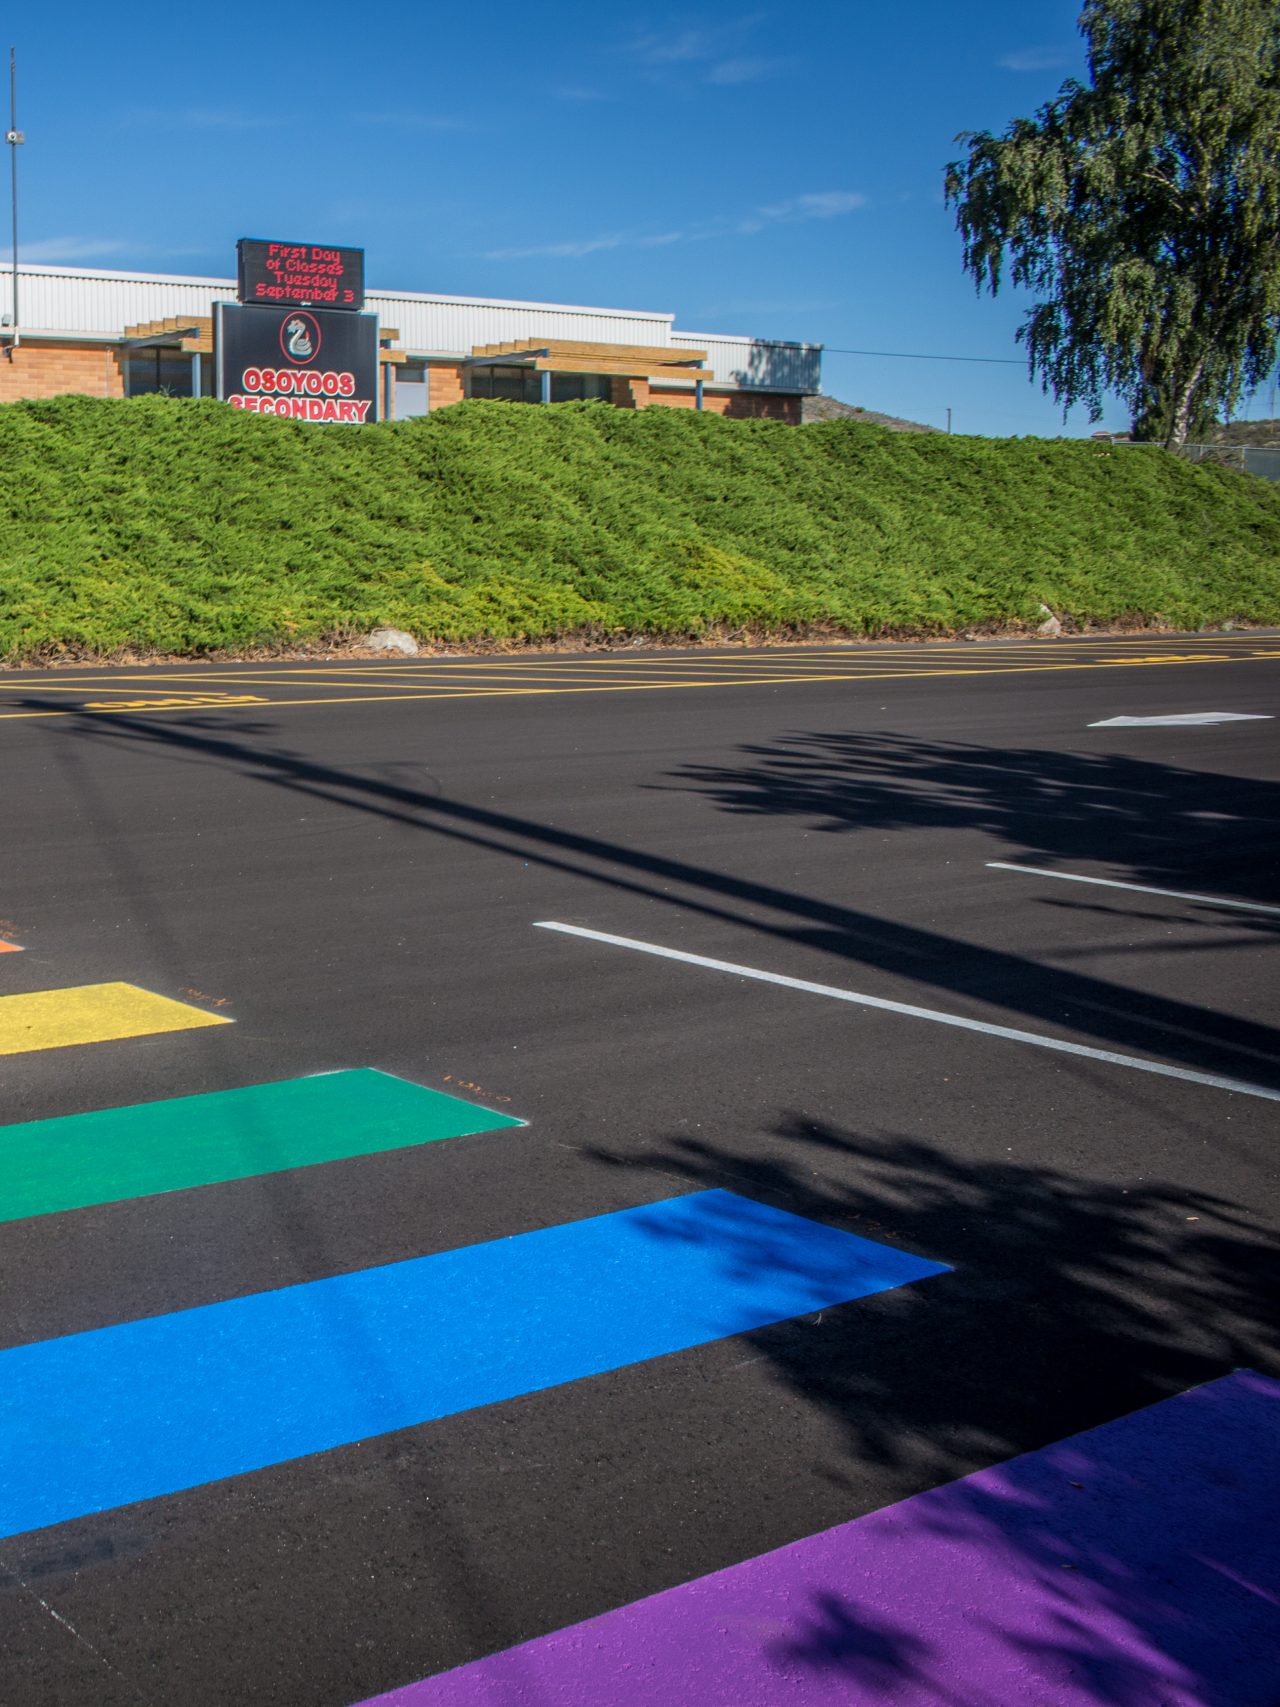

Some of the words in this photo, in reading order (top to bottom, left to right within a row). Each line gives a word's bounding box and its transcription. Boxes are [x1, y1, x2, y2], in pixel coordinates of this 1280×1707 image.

[268, 243, 308, 257] First
[311, 247, 341, 264] Day
[265, 258, 281, 270] of
[285, 258, 344, 275] Classes
[273, 270, 338, 291] Tuesday
[255, 283, 339, 302] September
[343, 289, 355, 303] 3
[242, 367, 355, 397] OSOYOOS
